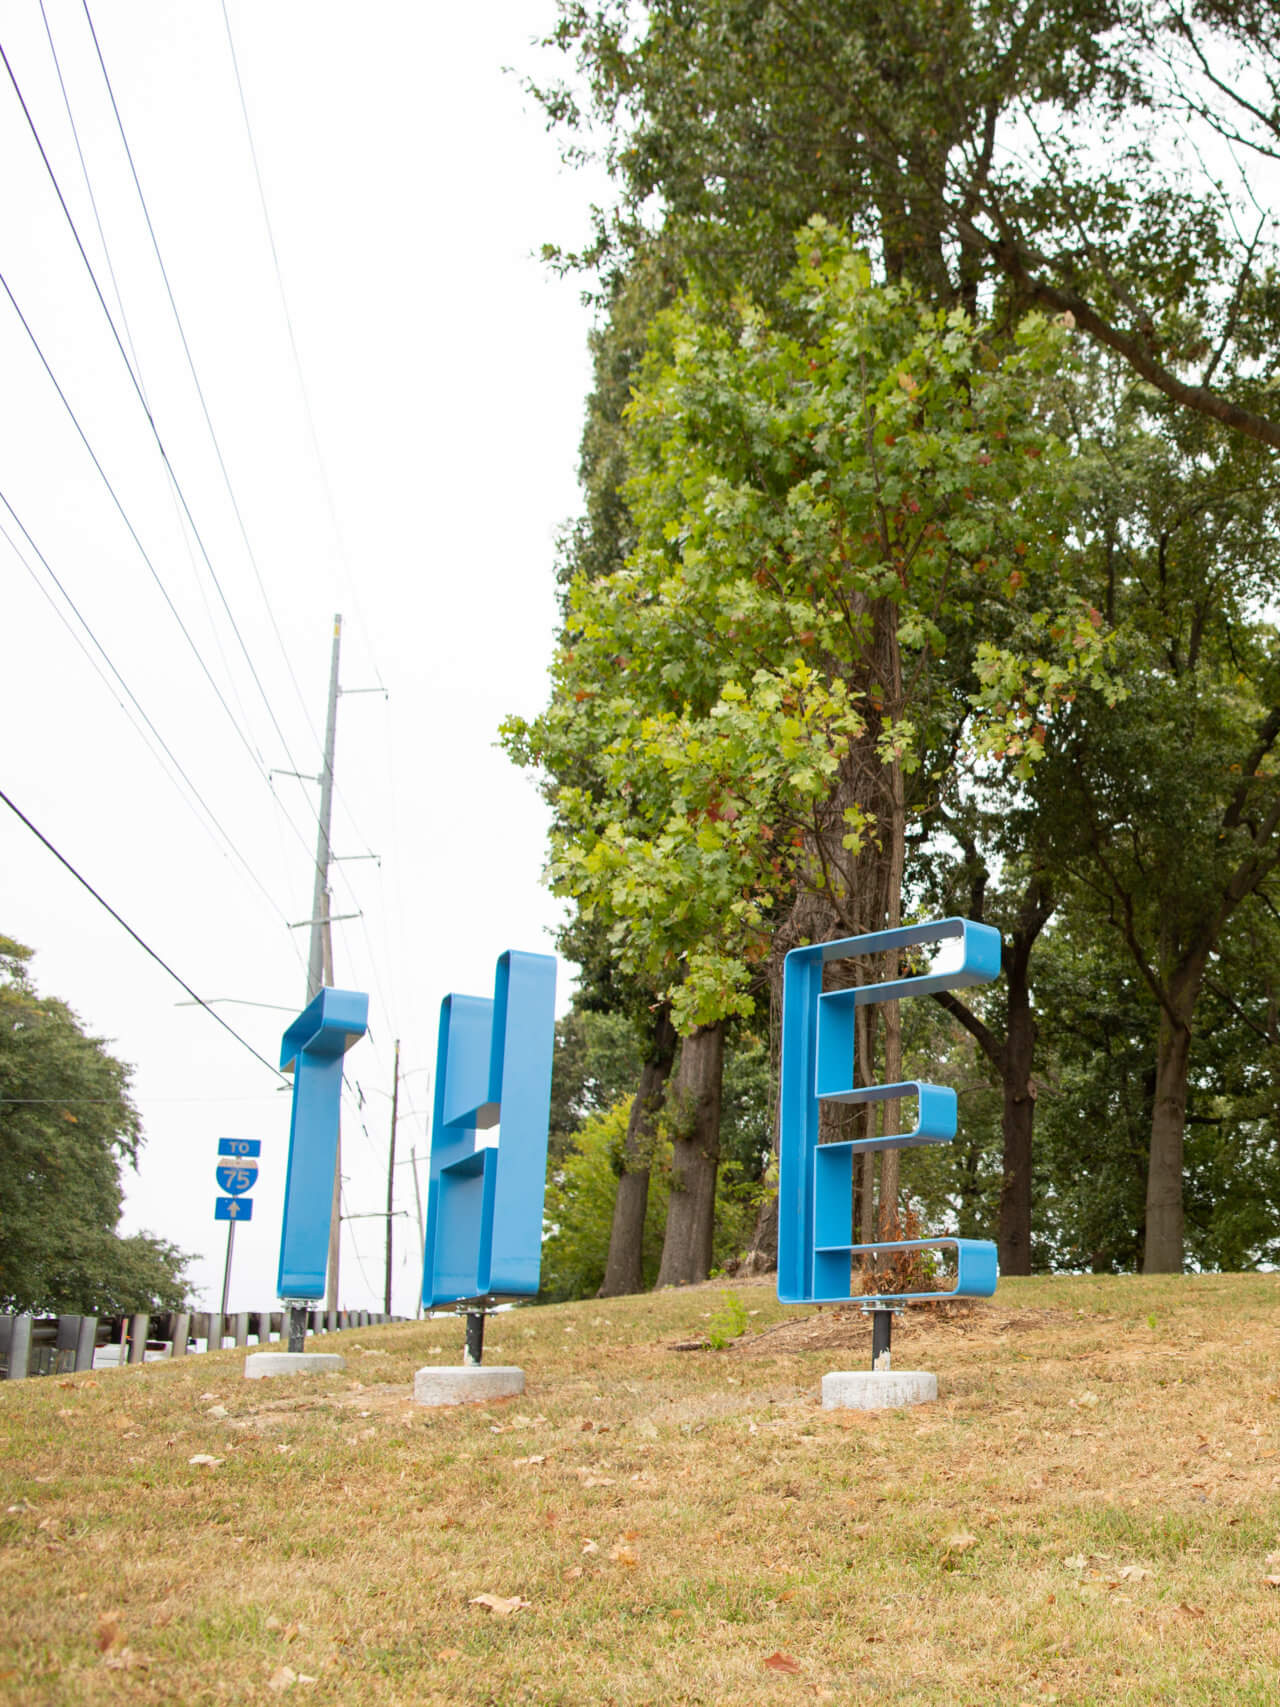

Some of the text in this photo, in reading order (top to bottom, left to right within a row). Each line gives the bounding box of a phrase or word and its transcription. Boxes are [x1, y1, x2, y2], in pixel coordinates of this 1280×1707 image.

[277, 916, 1002, 1312] THE
[229, 1141, 250, 1154] TO
[223, 1169, 250, 1189] 75
